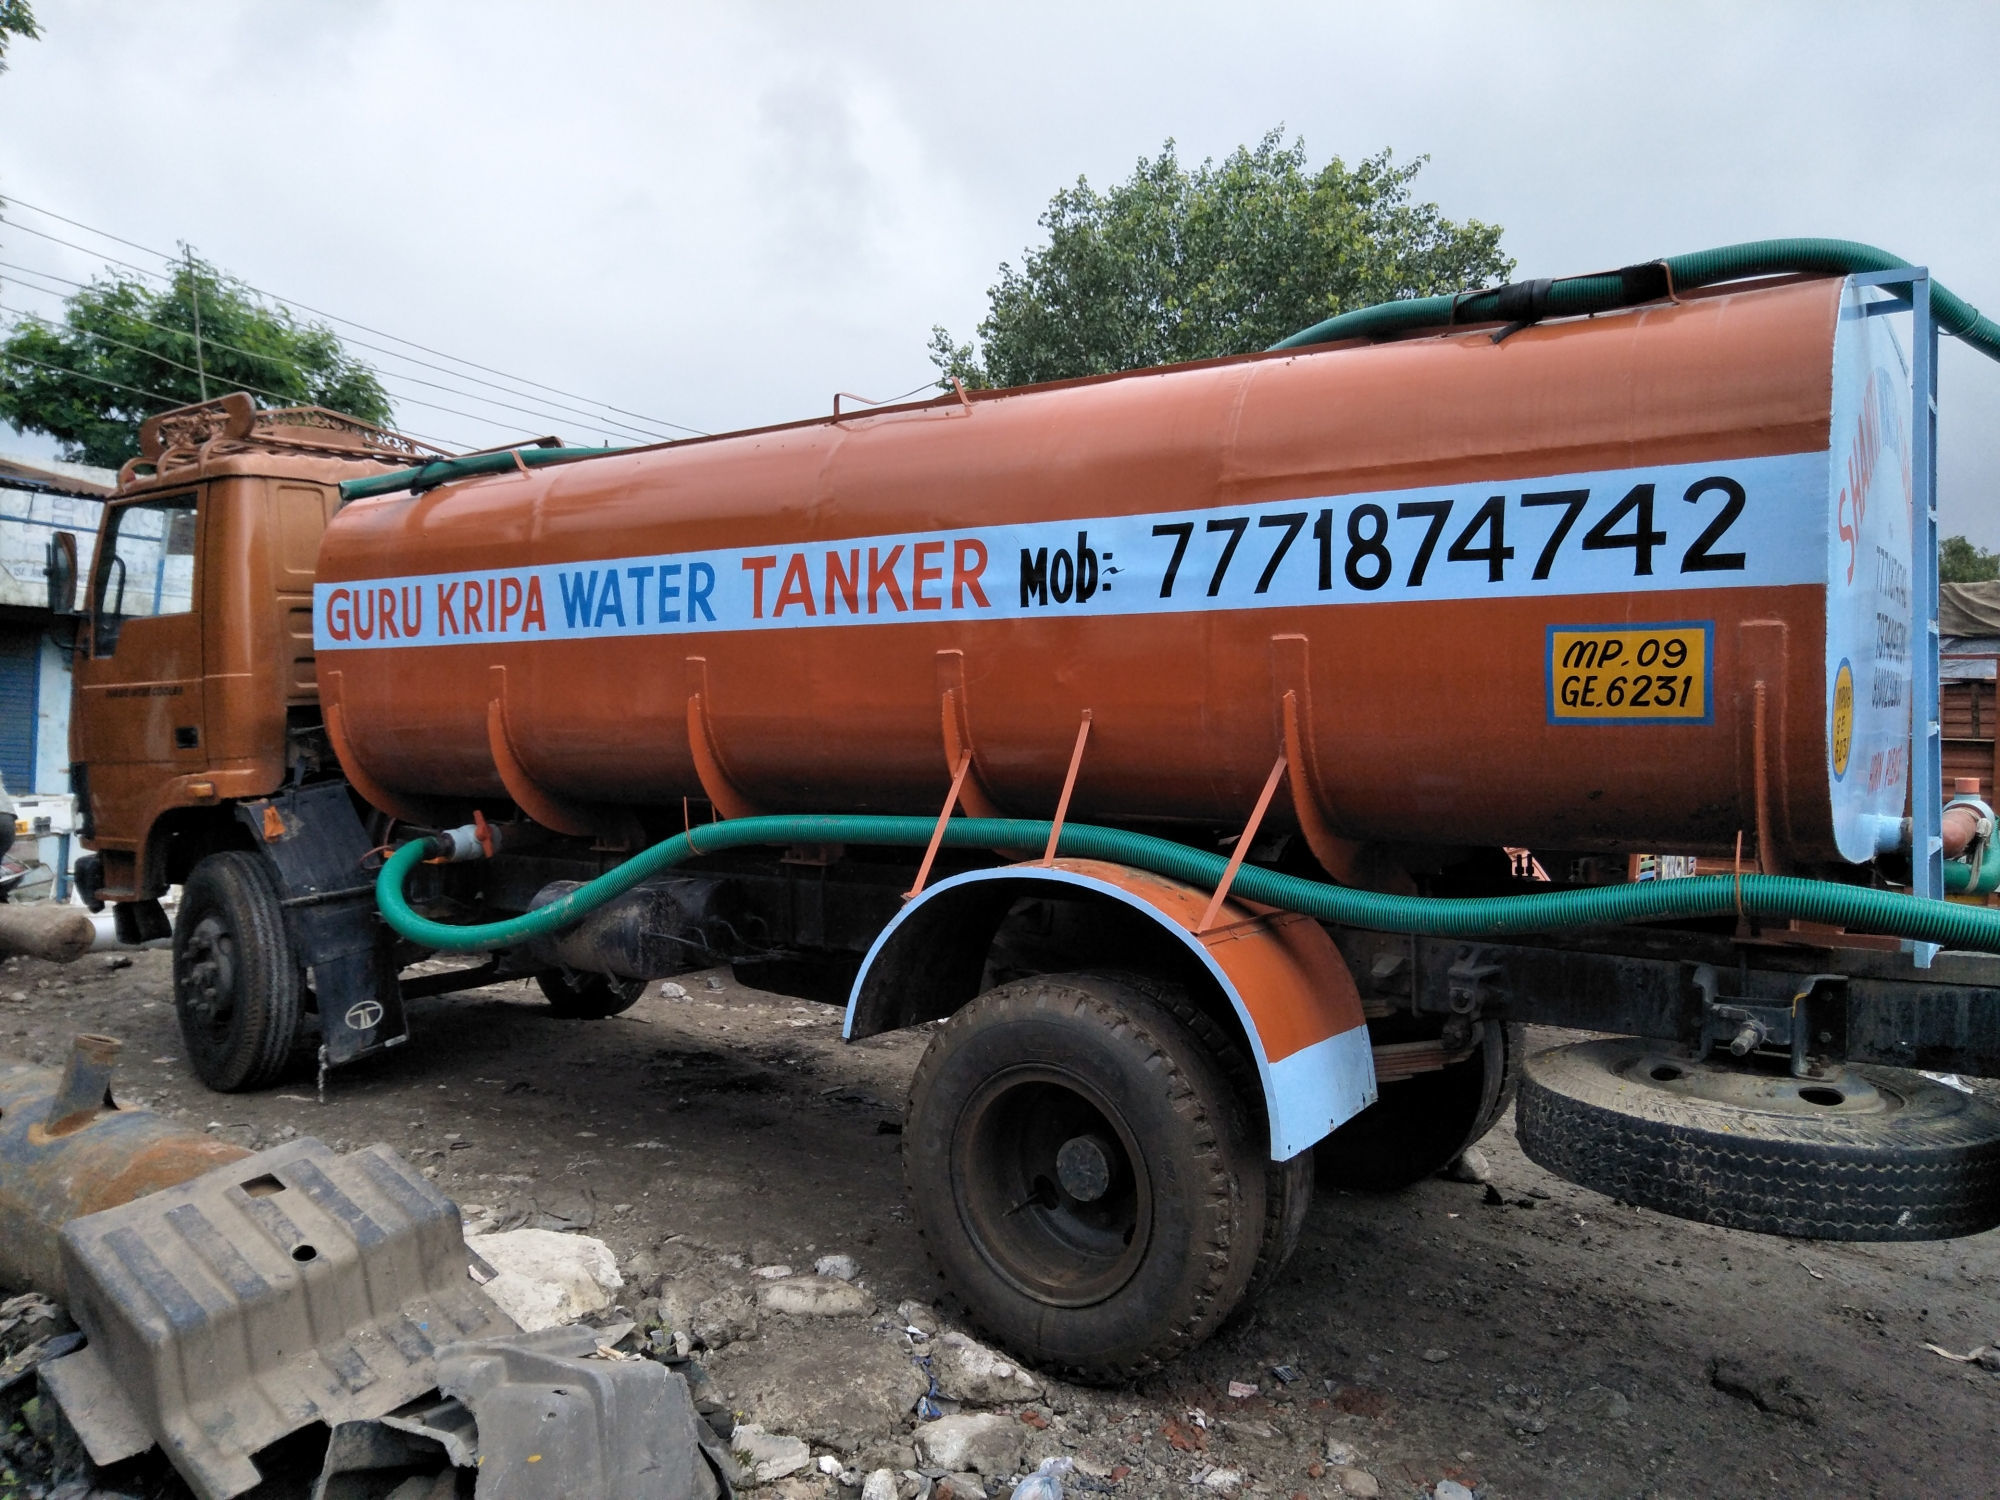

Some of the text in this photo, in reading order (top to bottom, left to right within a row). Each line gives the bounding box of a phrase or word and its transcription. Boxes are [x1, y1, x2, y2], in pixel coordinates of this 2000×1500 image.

[326, 586, 421, 641] GURU
[438, 576, 546, 635] KRIPA
[559, 562, 717, 628] WATER
[742, 538, 990, 619] TANKER
[1152, 476, 1747, 599] 7771874742
